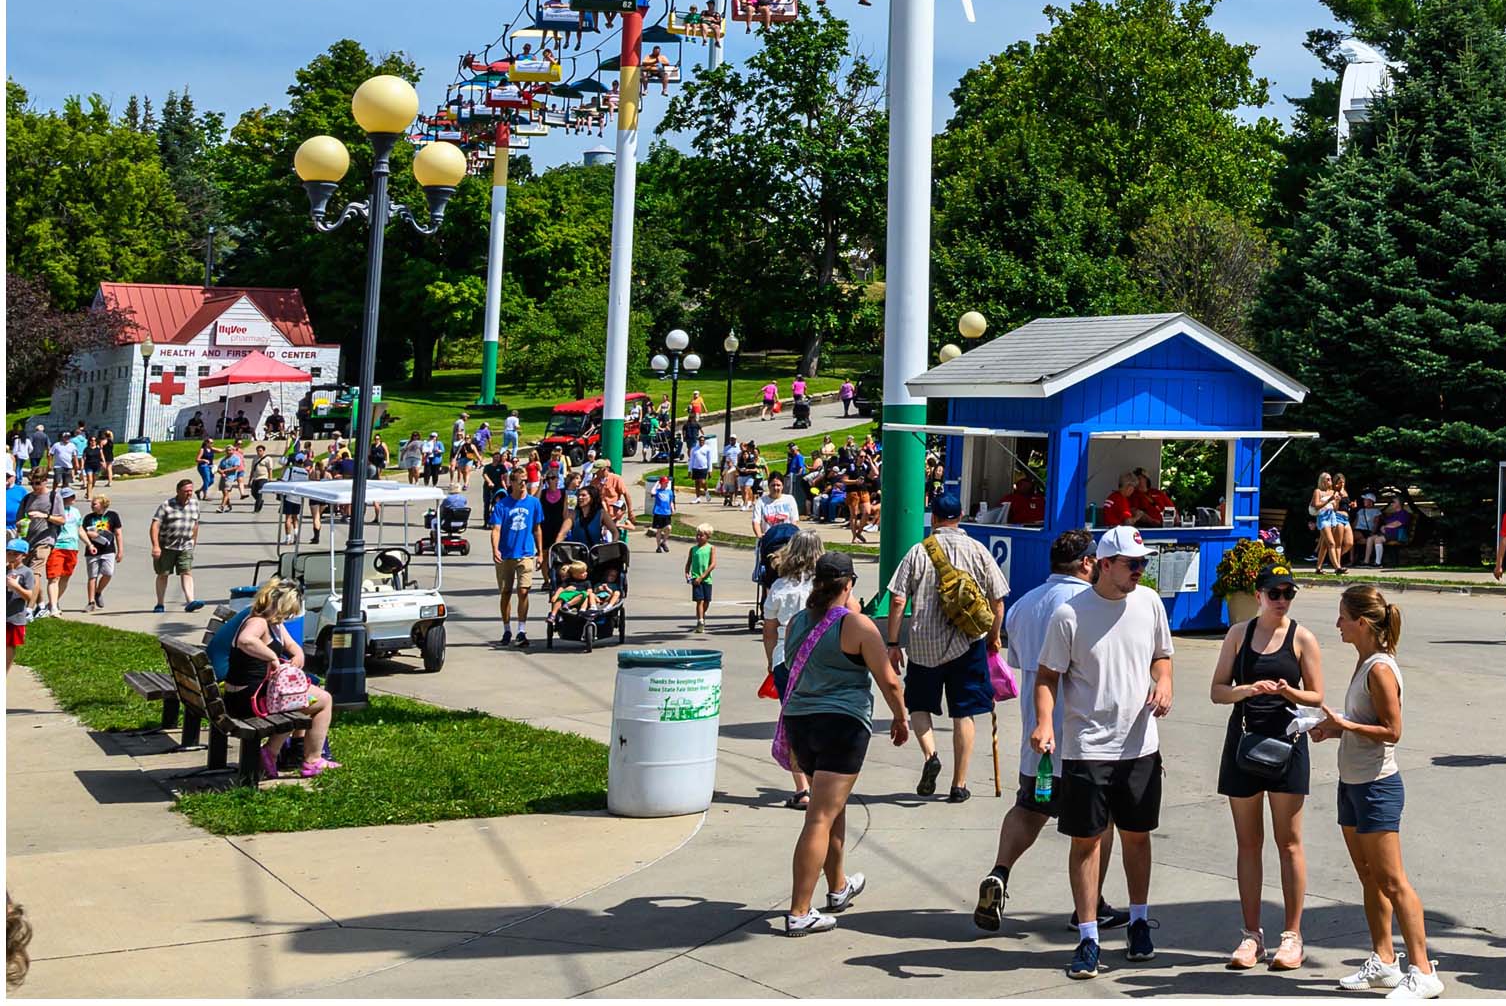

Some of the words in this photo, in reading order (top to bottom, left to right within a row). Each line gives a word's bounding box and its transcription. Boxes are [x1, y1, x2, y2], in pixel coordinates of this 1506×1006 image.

[622, 1, 632, 9] 62
[230, 334, 271, 343] pharmacy
[160, 349, 195, 357] HEALTH
[201, 349, 221, 357] AND
[281, 351, 317, 359] CENTER
